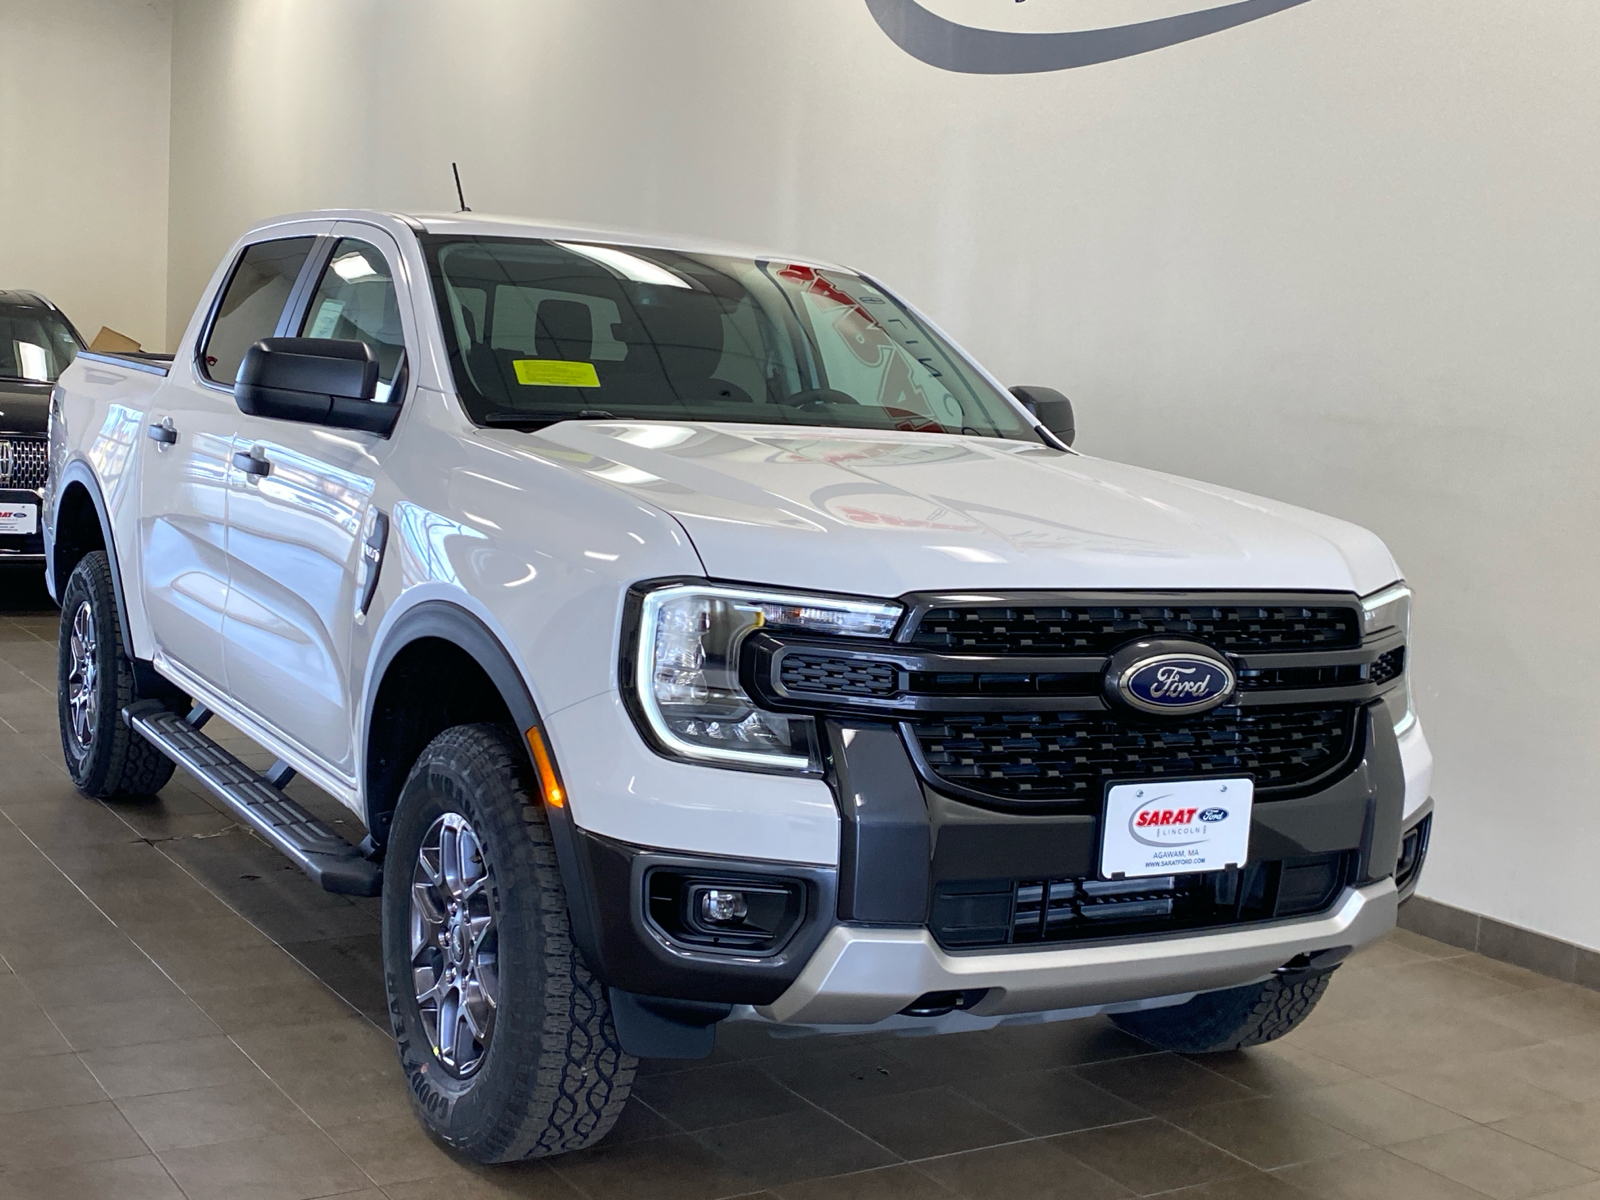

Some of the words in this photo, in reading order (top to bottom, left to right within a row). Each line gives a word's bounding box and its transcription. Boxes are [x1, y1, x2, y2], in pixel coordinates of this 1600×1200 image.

[1150, 666, 1211, 698] Ford
[1136, 808, 1198, 827] SARAT
[1203, 809, 1224, 821] Ford
[1153, 850, 1187, 859] AGAWAM,
[1187, 849, 1199, 857] MA
[1145, 858, 1206, 867] WWW.SARATFORD.COM
